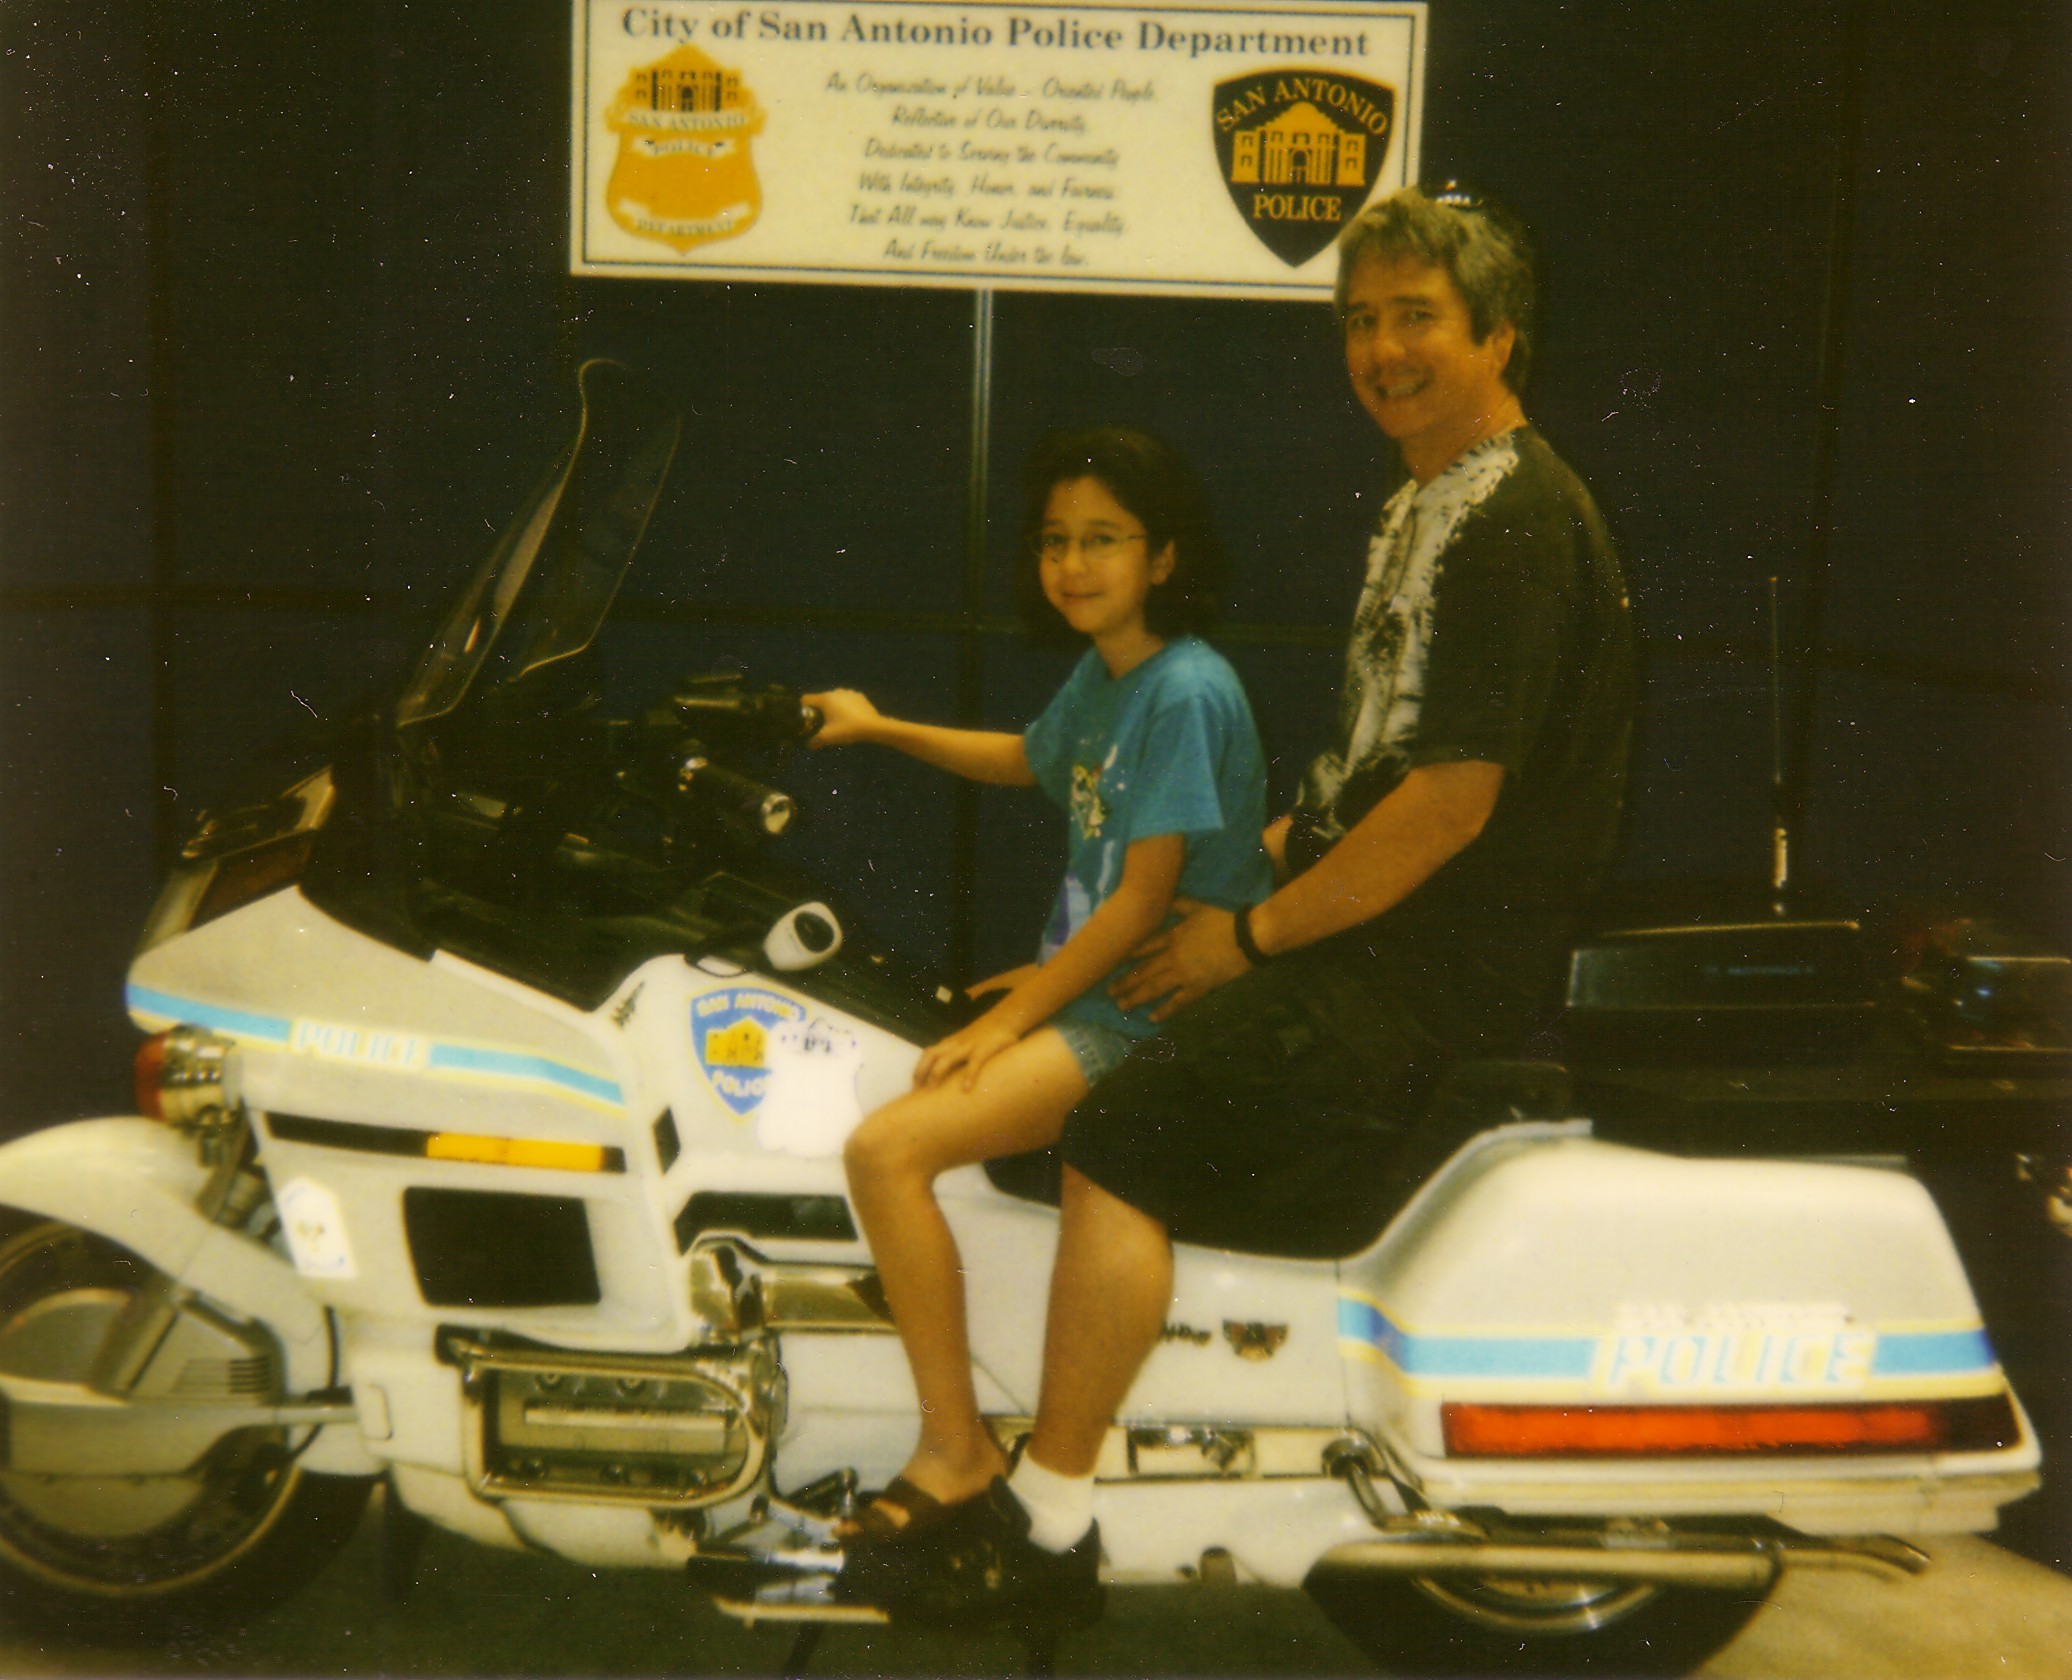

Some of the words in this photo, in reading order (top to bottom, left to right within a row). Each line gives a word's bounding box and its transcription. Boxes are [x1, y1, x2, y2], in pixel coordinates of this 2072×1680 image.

[622, 8, 699, 43] City
[711, 11, 751, 40] of
[758, 13, 828, 42] San
[841, 14, 992, 46] Antonio
[1007, 17, 1124, 50] Police
[1137, 21, 1369, 57] Department
[628, 112, 664, 130] SAN
[668, 113, 747, 132] ANTONIO
[1215, 84, 1268, 132] SAN
[1273, 78, 1389, 136] ANTONIO
[636, 217, 736, 237] DEPARTMENT
[1252, 192, 1343, 222] POLICE
[297, 1019, 426, 1070] POLICE
[712, 1067, 770, 1098] POLIC
[1604, 1329, 1867, 1390] POLICE
